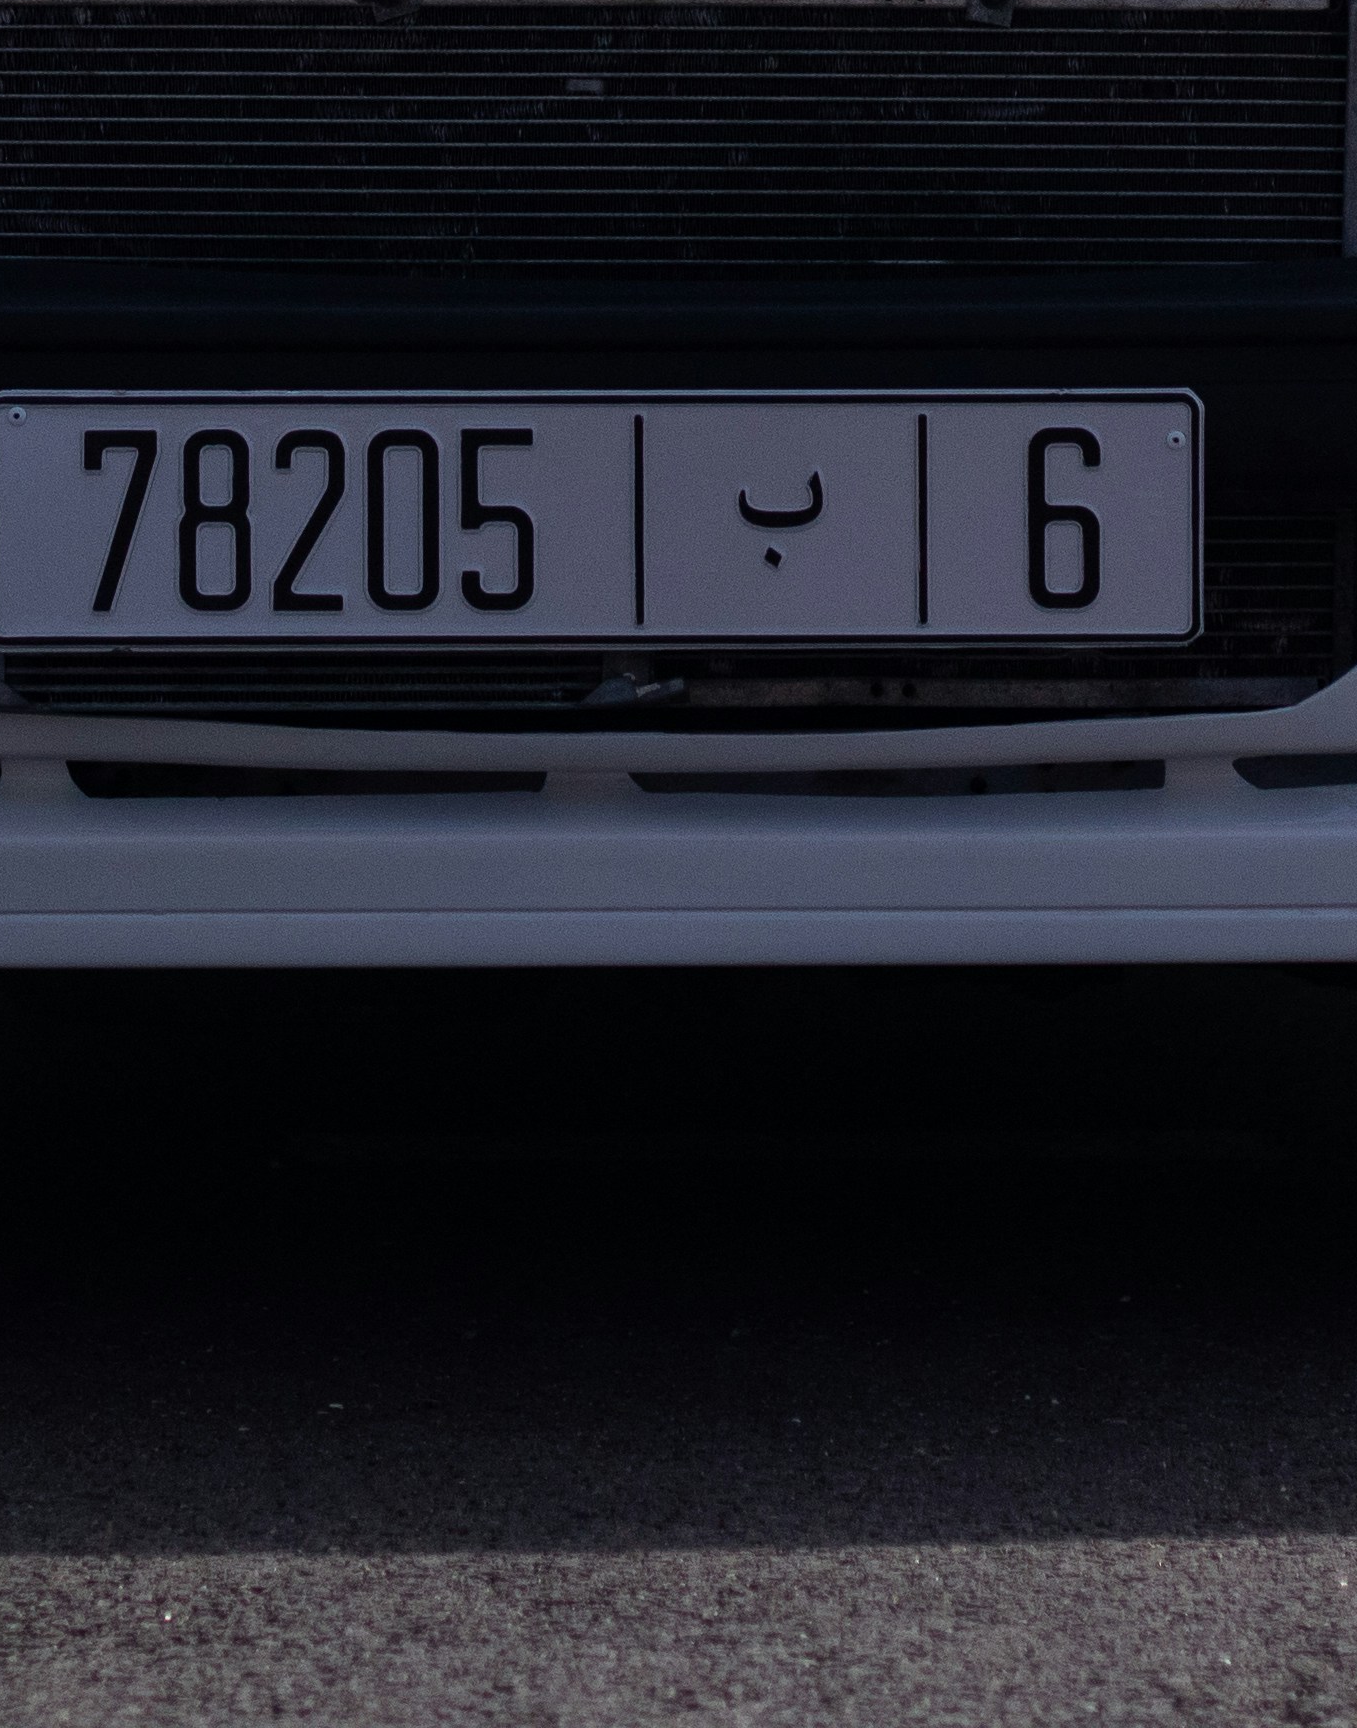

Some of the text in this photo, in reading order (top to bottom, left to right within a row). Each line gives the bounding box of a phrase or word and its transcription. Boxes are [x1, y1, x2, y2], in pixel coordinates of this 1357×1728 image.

[83, 427, 1102, 614] 78205 ب 6
